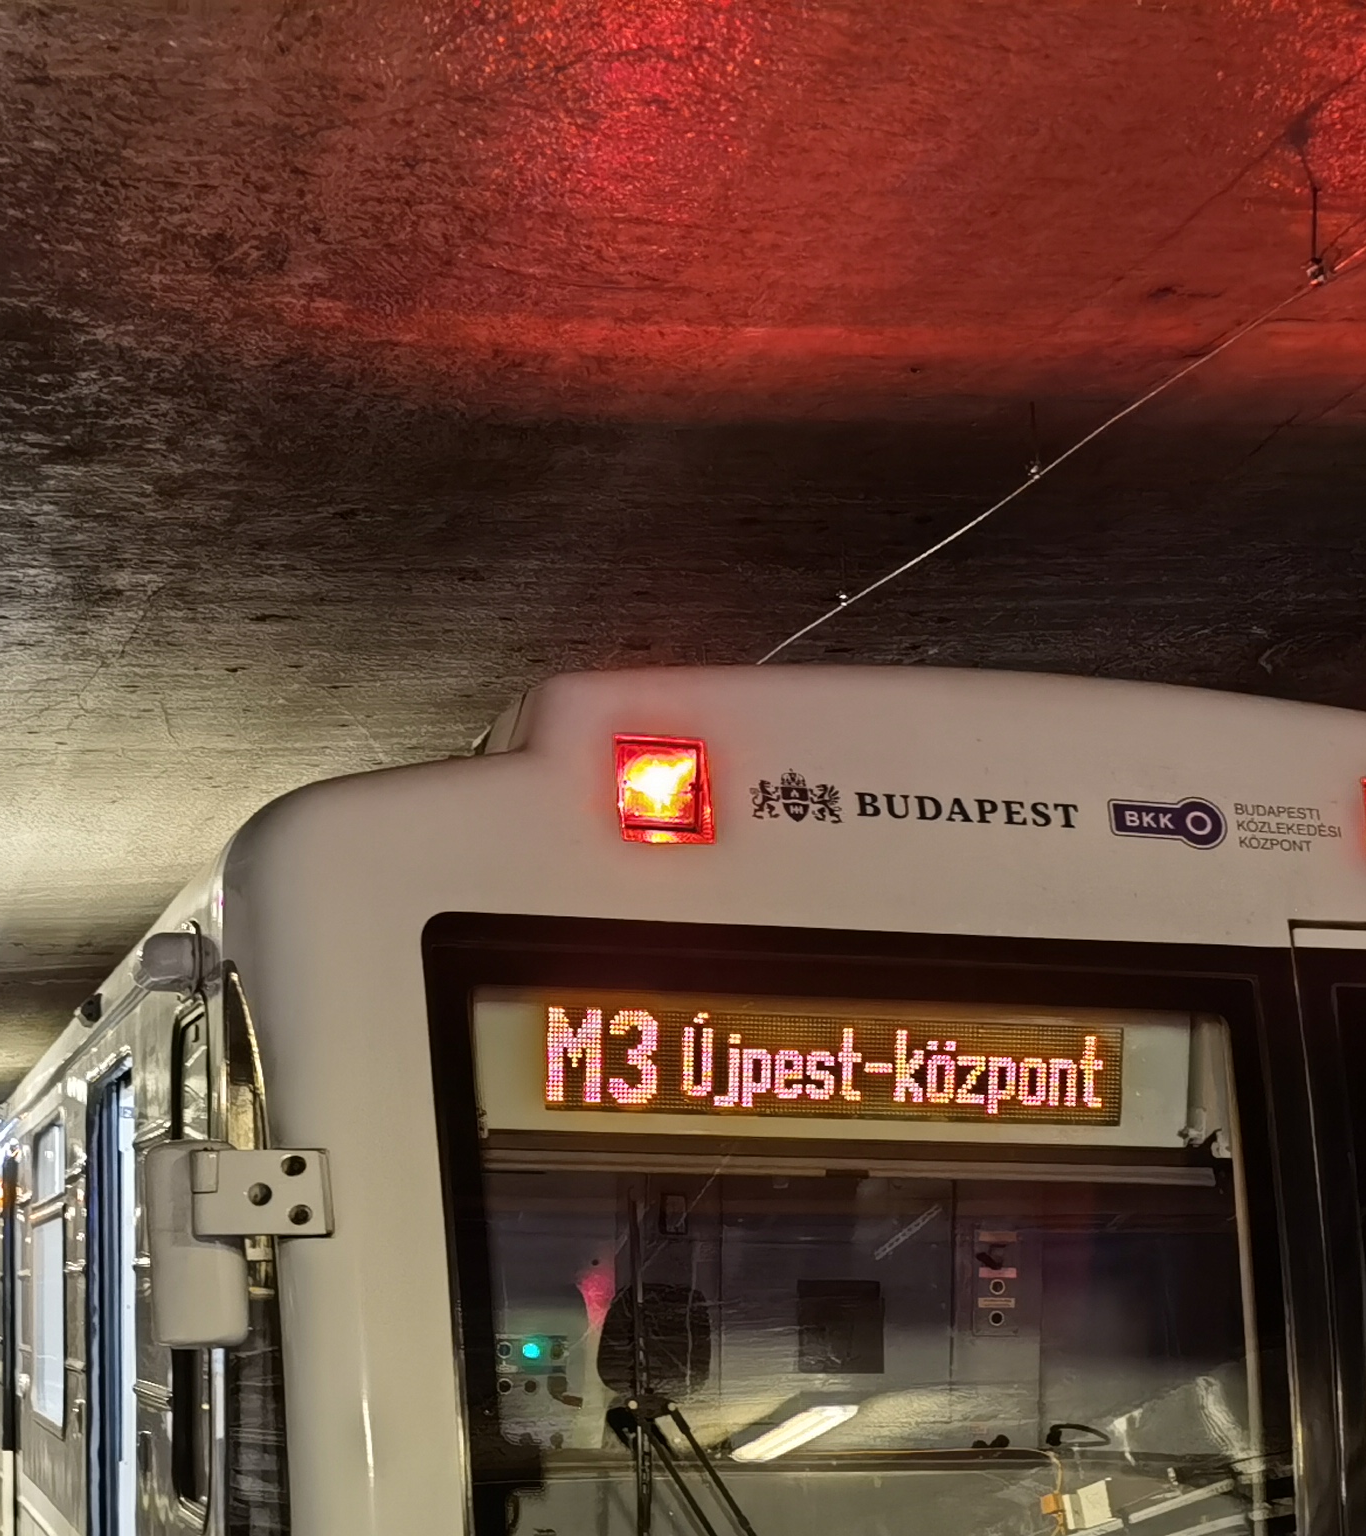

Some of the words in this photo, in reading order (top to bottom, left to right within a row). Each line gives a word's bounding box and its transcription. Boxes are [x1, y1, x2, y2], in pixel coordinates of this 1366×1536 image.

[854, 791, 1079, 829] BUDAPEST
[1123, 810, 1176, 830] BKK
[1233, 802, 1321, 821] BUDAPESTI
[545, 1006, 659, 1105] M3
[680, 1010, 1105, 1116] Újpest-központ
